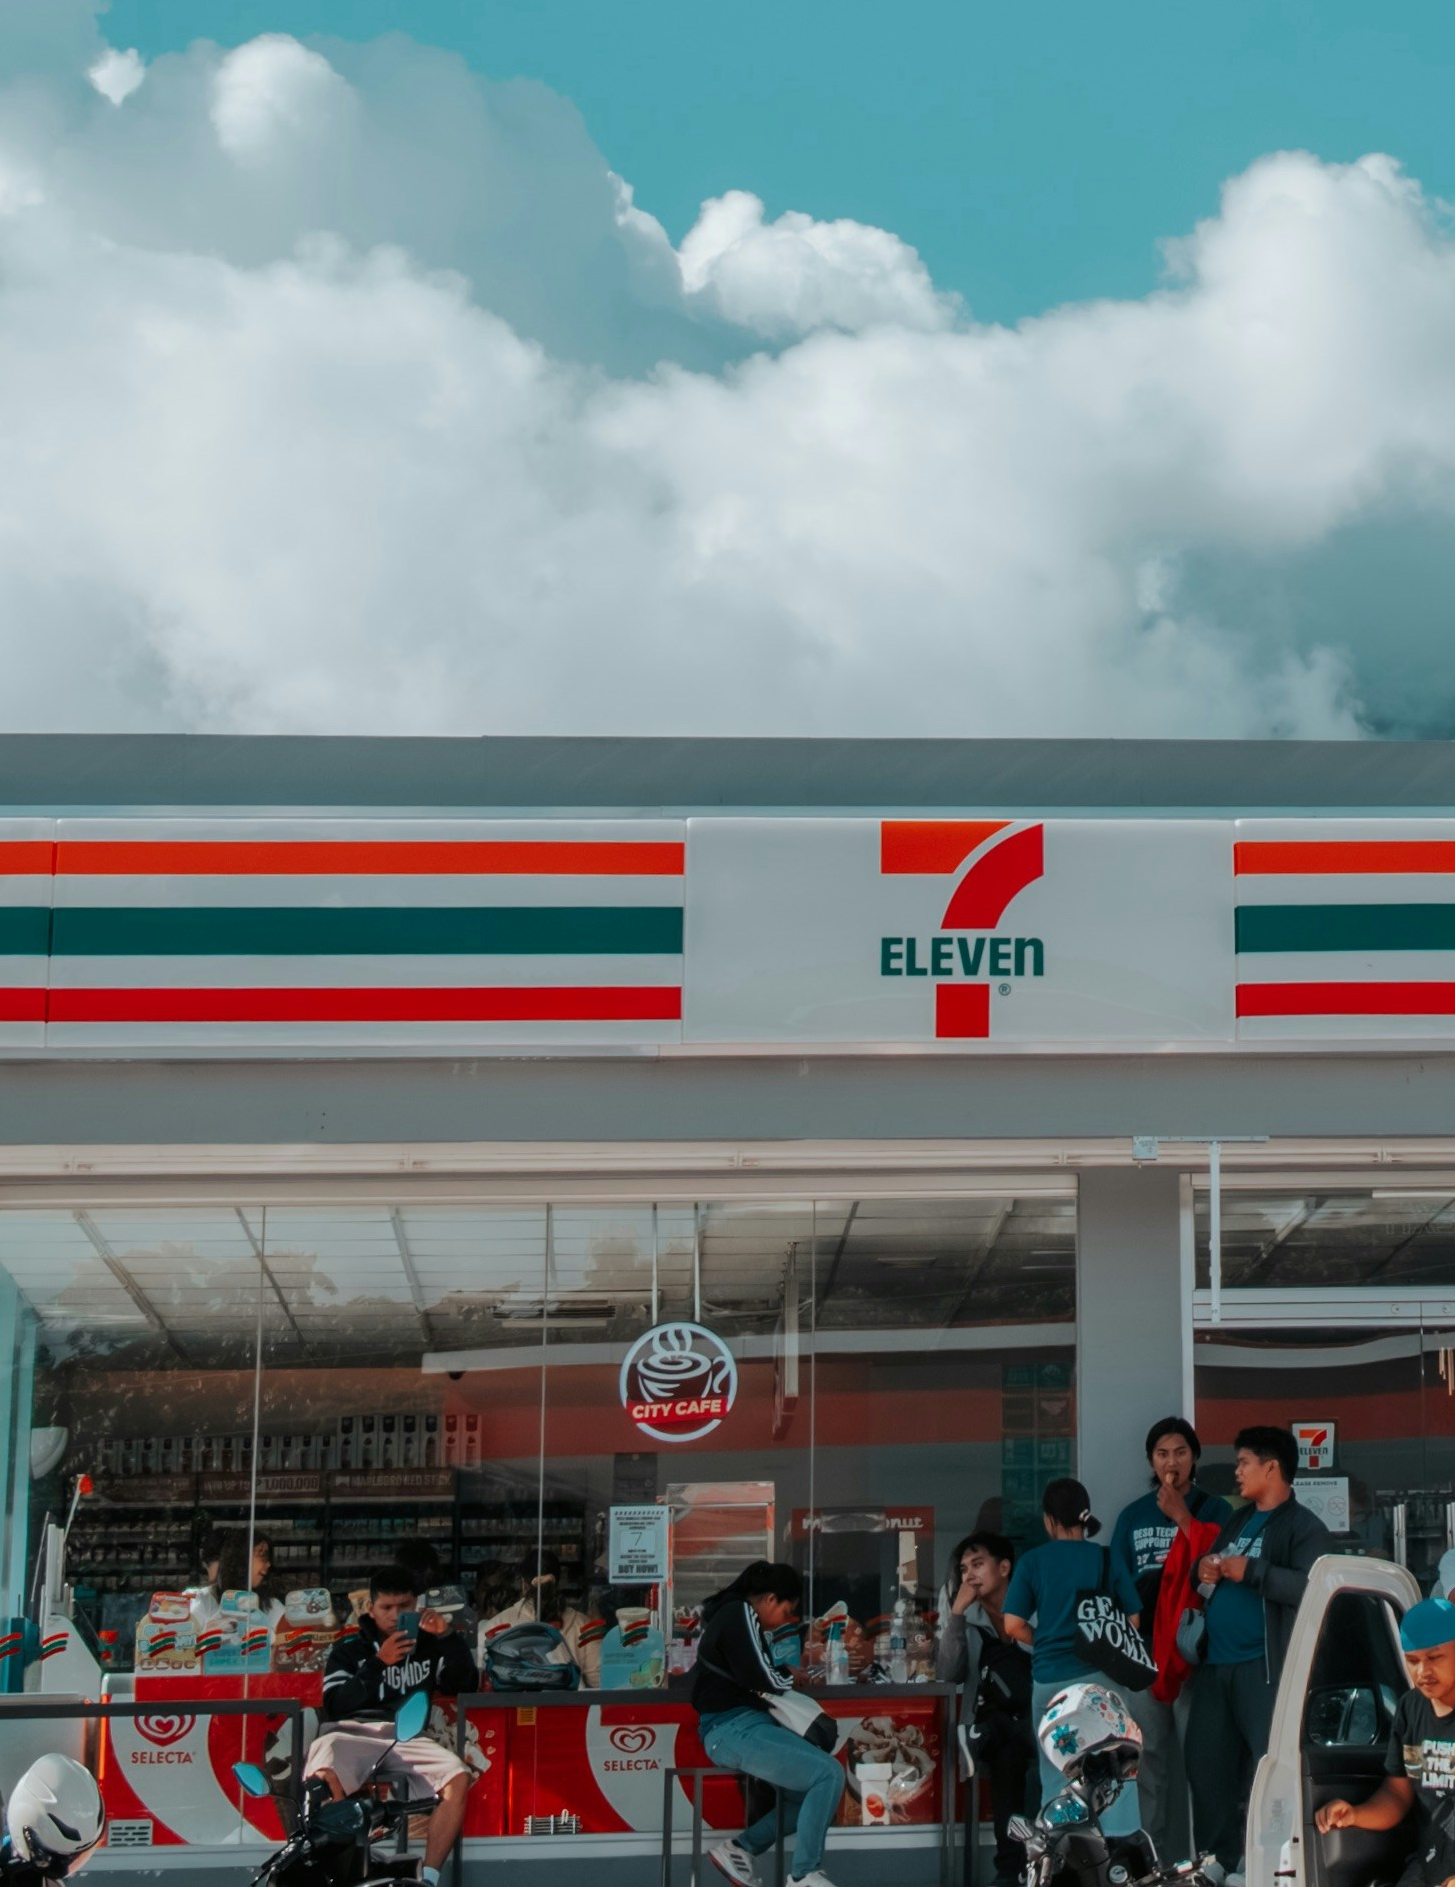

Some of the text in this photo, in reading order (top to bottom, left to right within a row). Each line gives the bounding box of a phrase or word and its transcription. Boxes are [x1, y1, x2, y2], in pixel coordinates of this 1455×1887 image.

[881, 821, 1044, 1038] 7
[632, 1399, 722, 1419] CITY CAFE
[1299, 1429, 1327, 1467] 7
[1134, 1537, 1171, 1550] SUPPORT
[618, 1564, 658, 1574] BUY NOW!
[1422, 1739, 1455, 1756] PUSH
[131, 1751, 193, 1765] SELECTA
[603, 1759, 659, 1772] SELECTA
[1426, 1757, 1451, 1773] THE
[1421, 1771, 1455, 1789] LIMIT
